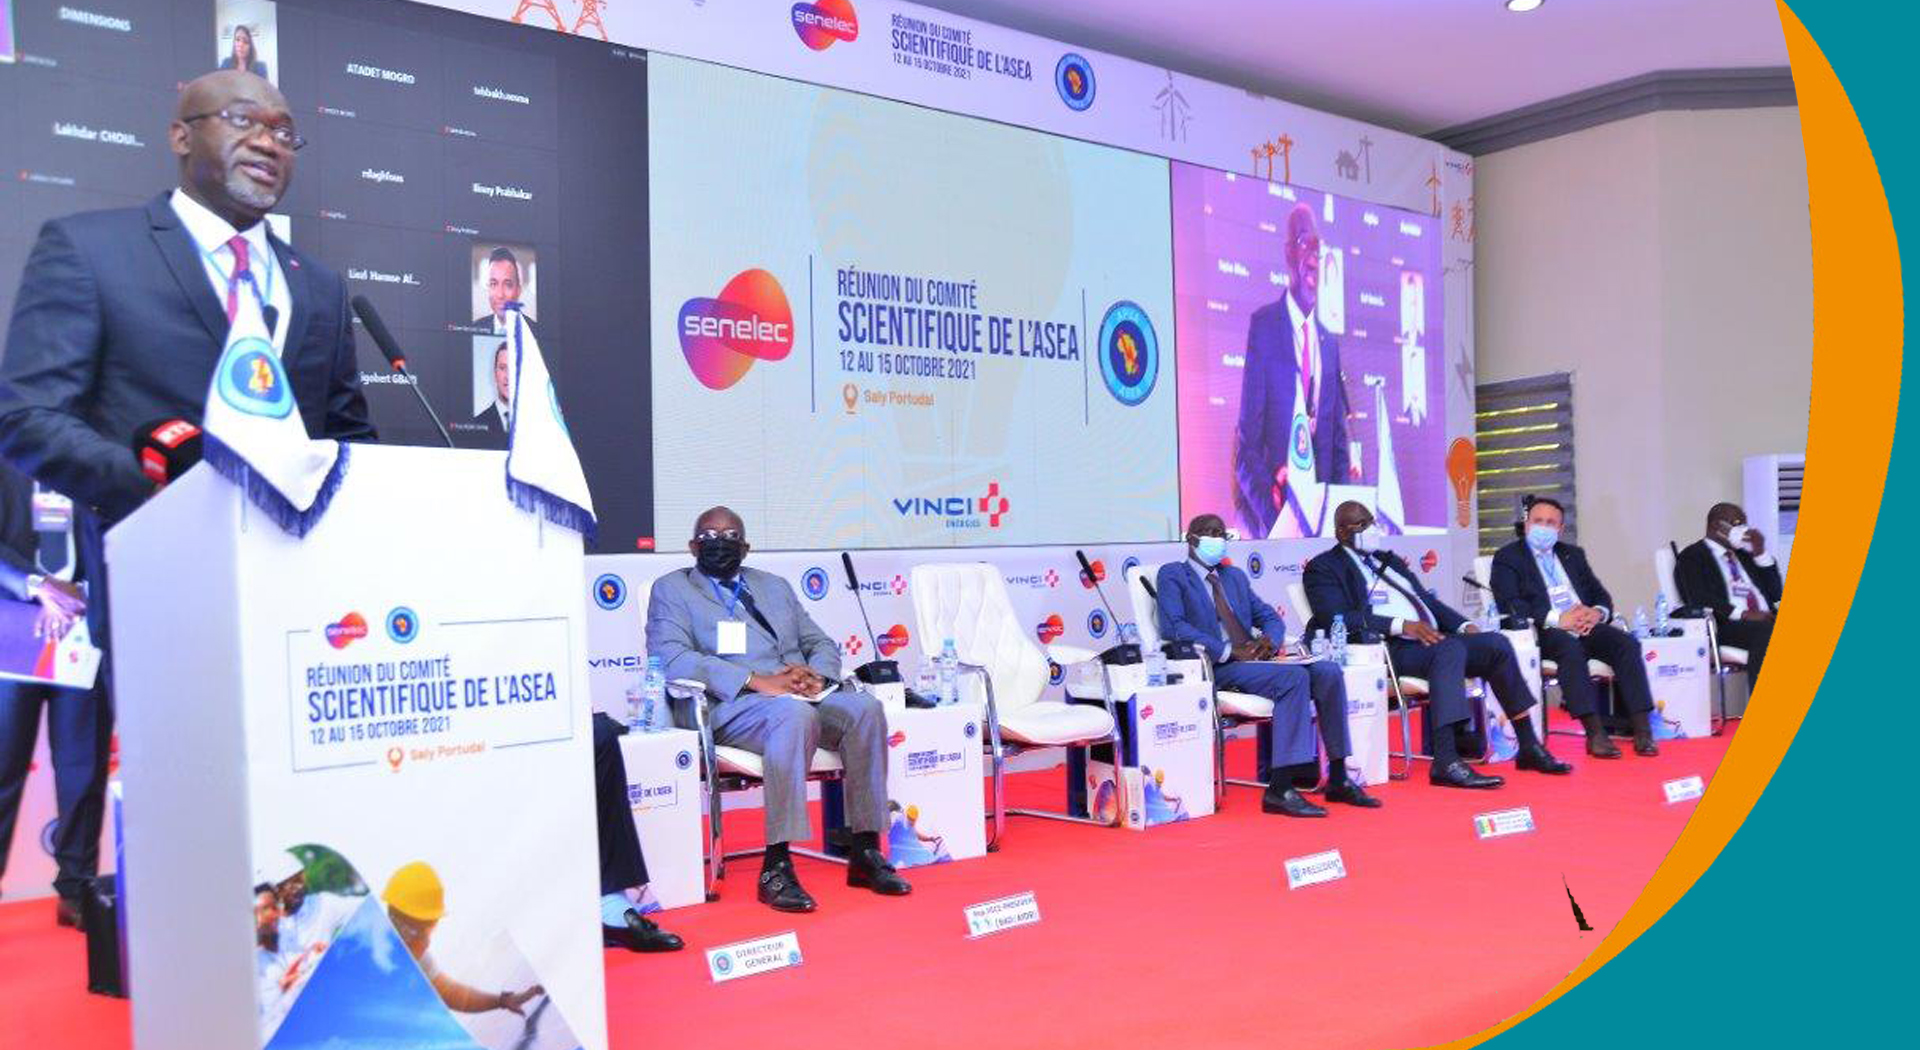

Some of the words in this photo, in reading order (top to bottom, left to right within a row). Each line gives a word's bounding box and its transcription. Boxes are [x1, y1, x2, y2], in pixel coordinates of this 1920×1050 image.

[59, 6, 131, 31] DIMENSIONS
[794, 10, 857, 34] senelec
[891, 13, 928, 37] RÉUNION
[929, 22, 941, 37] DU
[942, 24, 972, 45] COMITÉ
[891, 29, 974, 67] SCIENTIFIQUE
[977, 50, 993, 71] DE
[995, 53, 1032, 81] L'ASEA
[893, 53, 901, 64] 12
[923, 59, 951, 77] OCTOBRE
[953, 66, 971, 80] 2021
[347, 63, 380, 78] ATADET
[54, 121, 97, 140] Lakhdar
[837, 265, 900, 301] RÉUNION
[905, 277, 923, 304] DU
[927, 279, 977, 310] COMITÉ
[684, 313, 789, 343] senelec
[838, 300, 982, 355] SCIENTIFIQUE
[989, 316, 1013, 355] DE
[1019, 319, 1079, 361] L'ASEA
[840, 350, 854, 372] 12
[858, 352, 873, 373] AU
[878, 353, 892, 375] 15
[895, 354, 945, 378] OCTOBRE
[948, 359, 976, 380] 2021
[360, 371, 390, 385] igobert
[863, 389, 886, 406] Saly
[889, 390, 935, 407] Portudal
[893, 497, 972, 516] VINCI
[845, 581, 887, 591] VNCI
[307, 662, 372, 688] RÉUNION
[377, 662, 396, 682] DU
[400, 654, 451, 680] COMITÉ
[588, 655, 641, 668] VINCI
[308, 680, 457, 723] SCIENTIFIQUE
[464, 677, 488, 708] DE
[495, 672, 557, 705] L'ASEA
[310, 728, 324, 745] 12
[329, 725, 345, 743] AU
[350, 724, 364, 741] 15
[367, 719, 419, 739] OCTOBRE
[422, 716, 451, 734] 2021
[410, 748, 434, 762] Saly
[438, 741, 486, 758] Portudal
[745, 953, 783, 969] GENERAL
